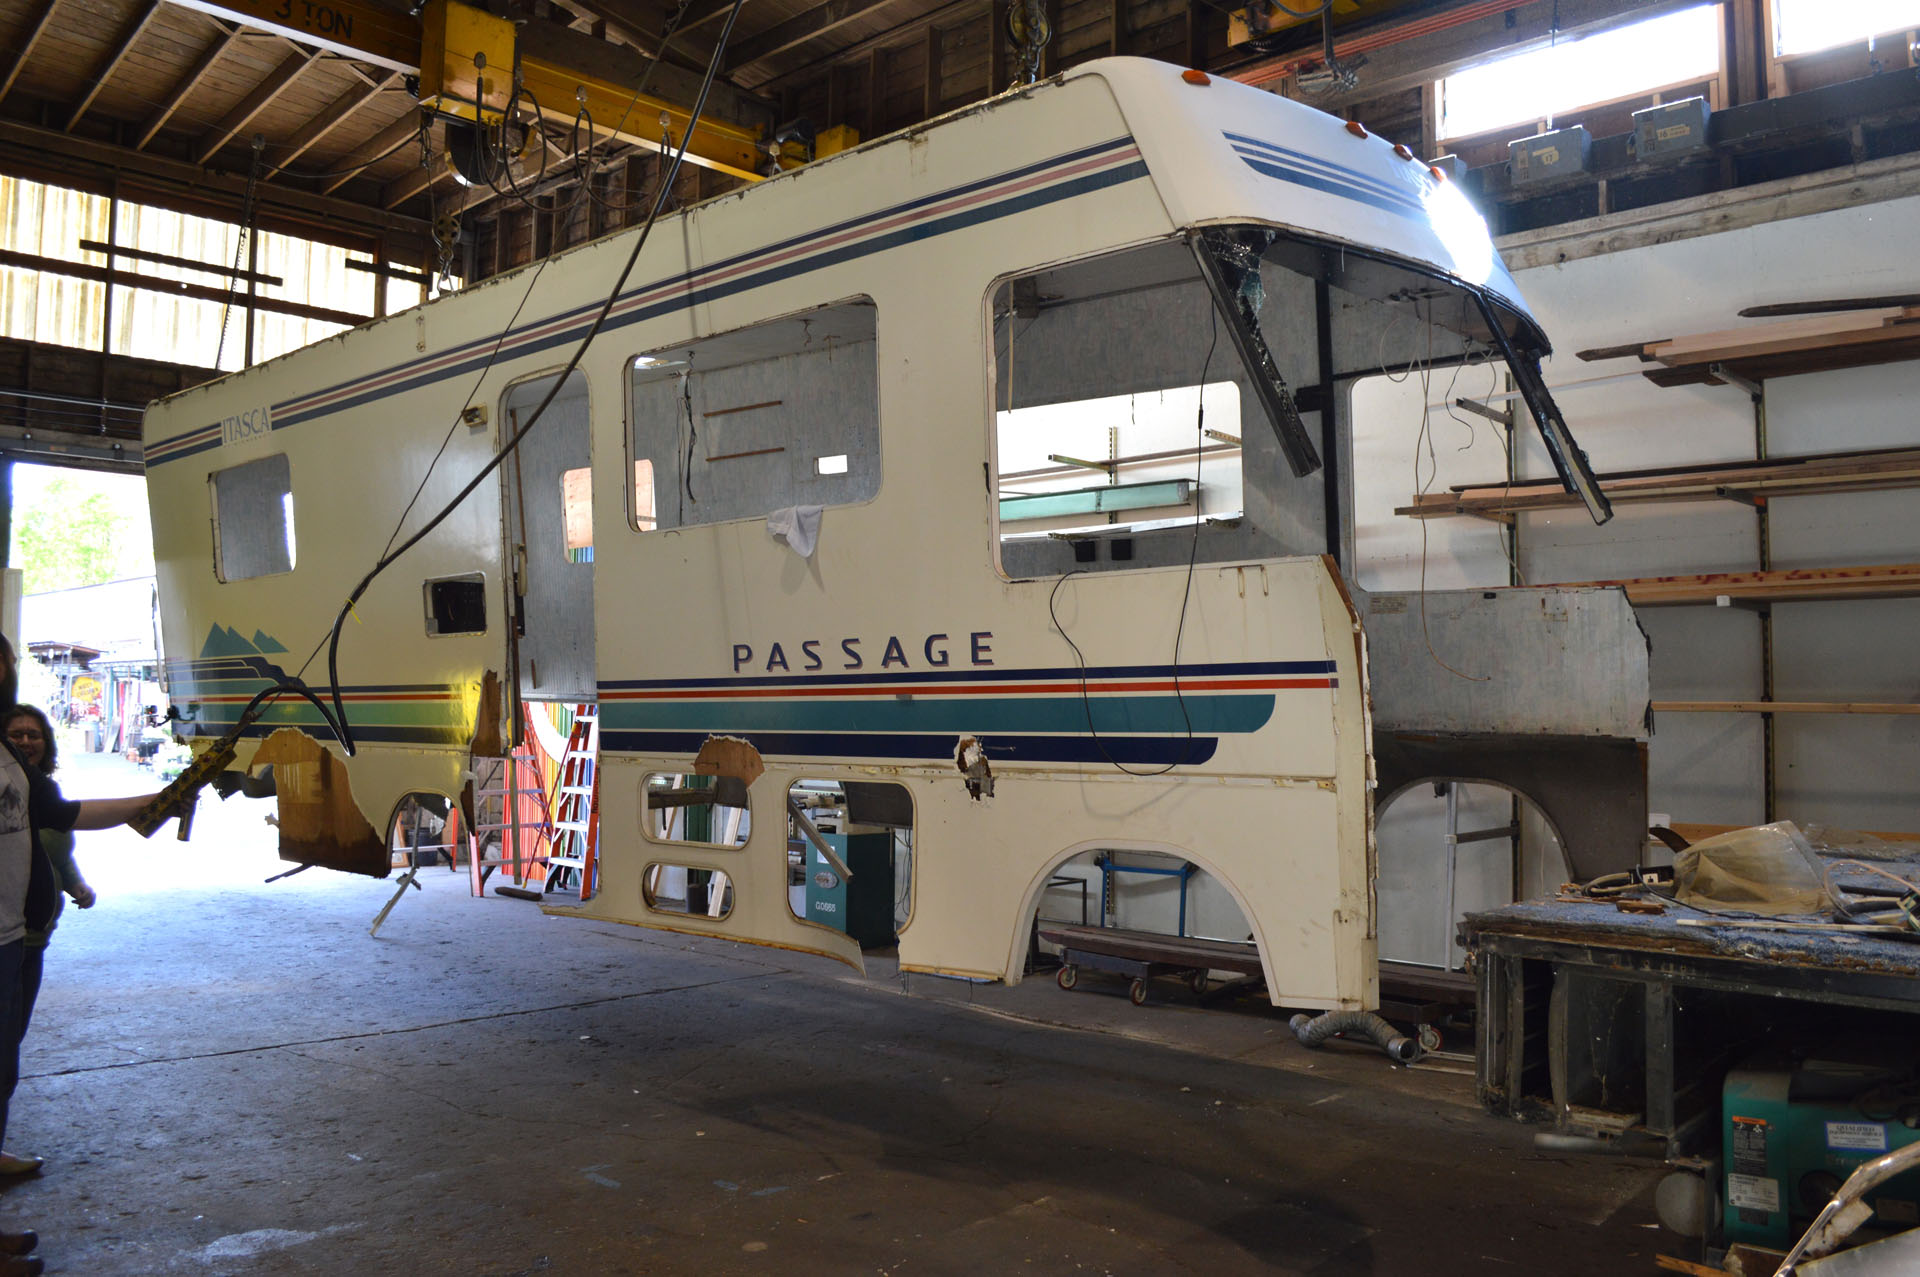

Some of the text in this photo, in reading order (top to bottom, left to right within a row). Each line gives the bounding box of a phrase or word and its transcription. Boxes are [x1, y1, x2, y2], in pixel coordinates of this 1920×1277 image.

[303, 0, 353, 39] TON
[222, 407, 270, 443] ITASCA
[733, 631, 994, 673] PASSAGE
